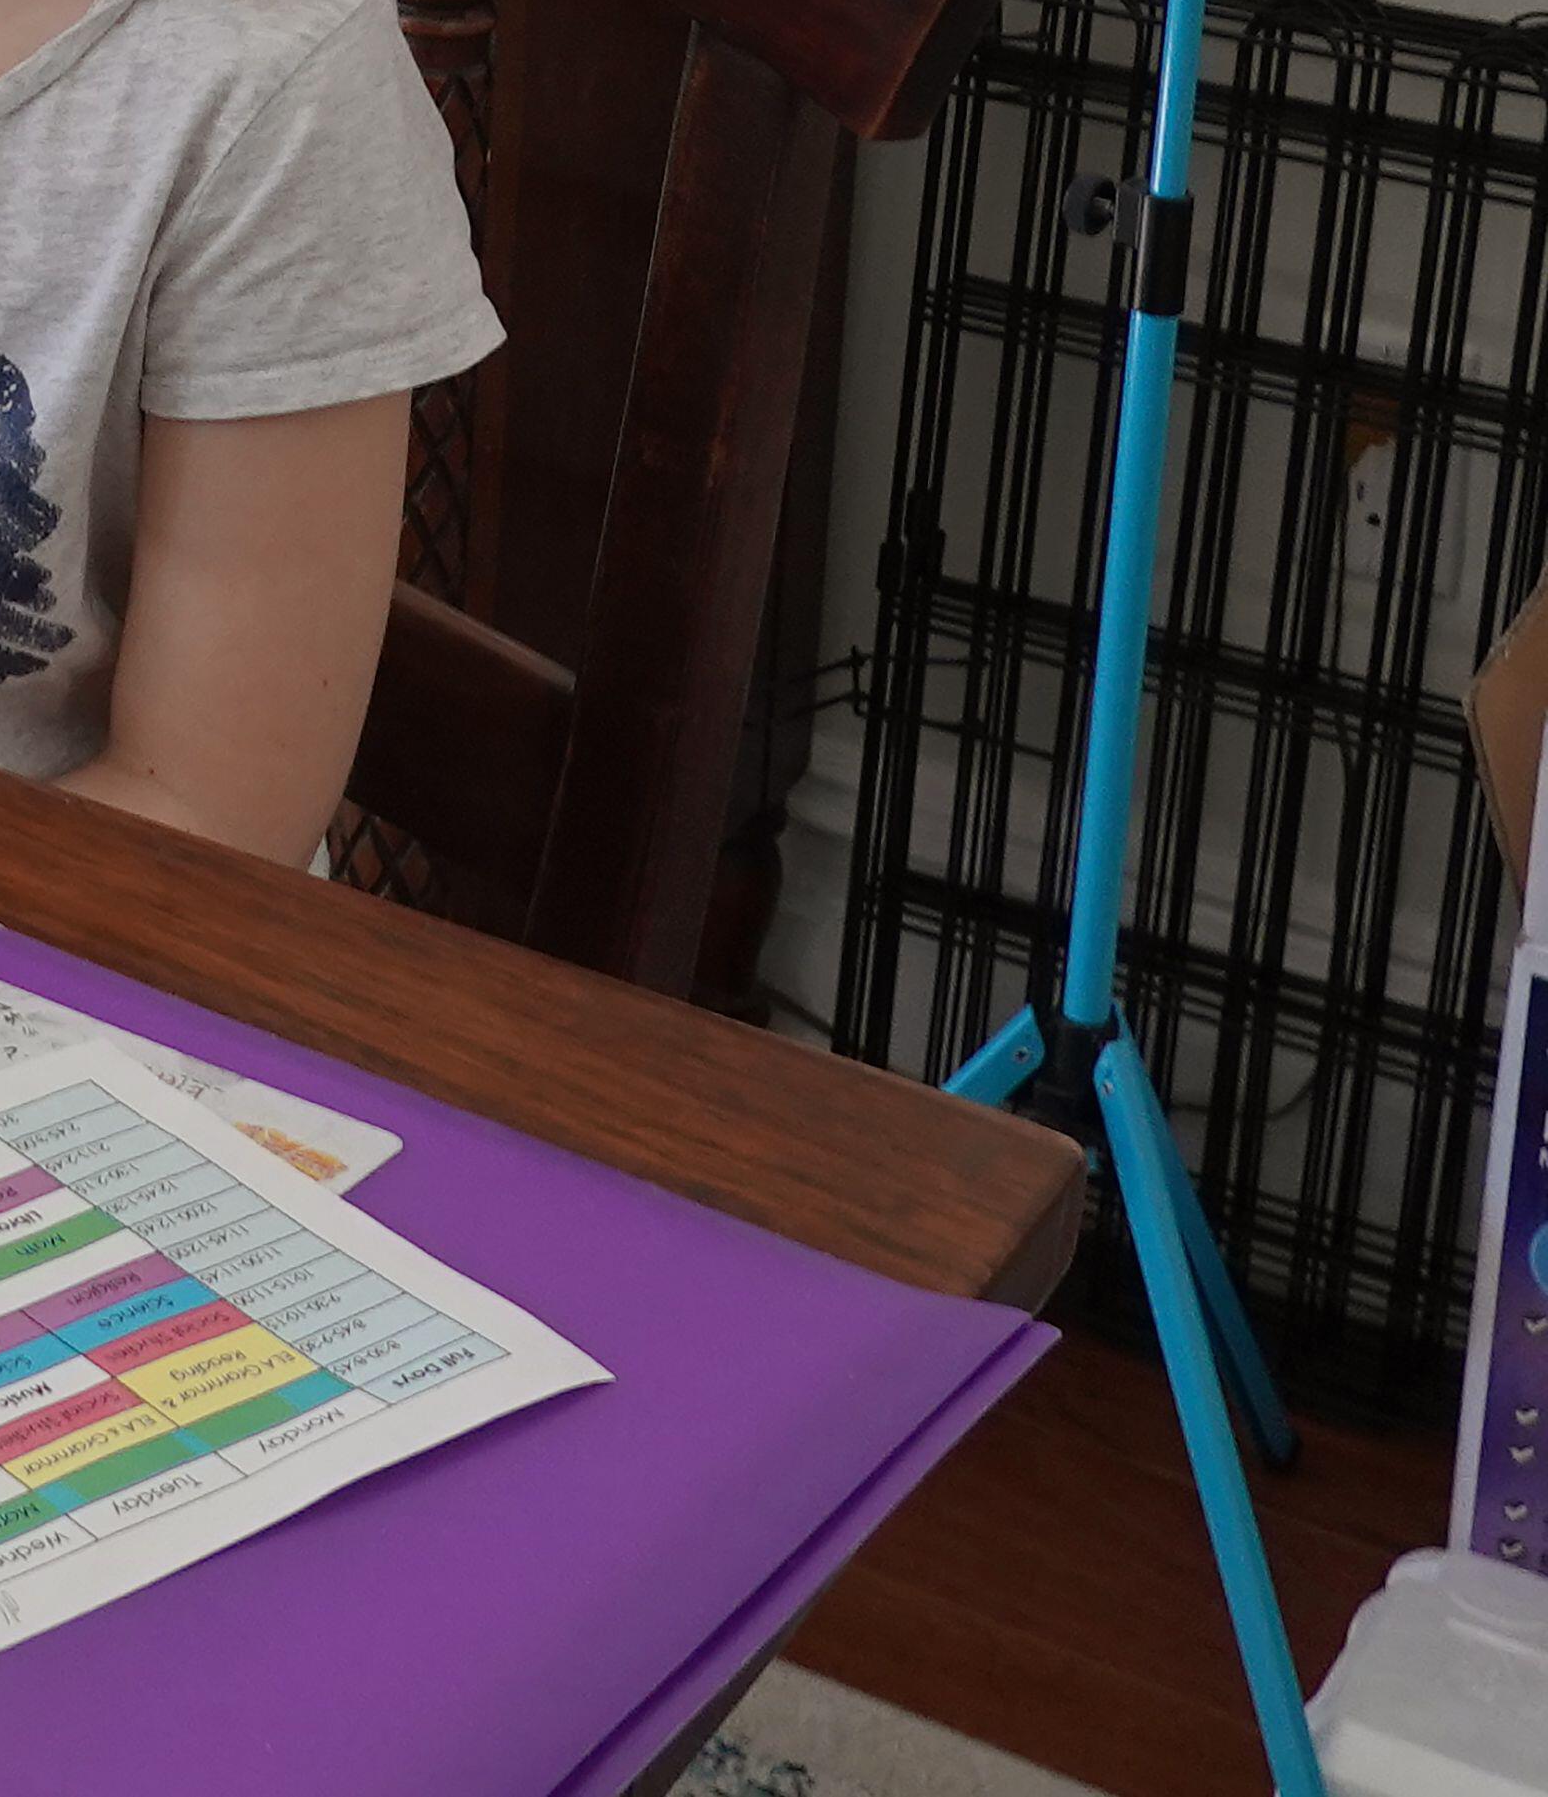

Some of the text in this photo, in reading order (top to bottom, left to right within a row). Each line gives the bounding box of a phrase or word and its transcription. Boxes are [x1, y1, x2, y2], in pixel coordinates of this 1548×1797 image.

[16, 1234, 65, 1254] Math
[69, 1272, 140, 1304] Religion
[98, 1295, 173, 1327] Science
[111, 1311, 229, 1359] Social Studies
[169, 1351, 245, 1380] Reading
[3, 1383, 51, 1406] Music
[180, 1365, 261, 1401] Grammar
[60, 1392, 119, 1421] Social
[258, 1409, 343, 1452] Monday
[24, 1433, 108, 1474] Grammar
[112, 1475, 200, 1514] Tuesday
